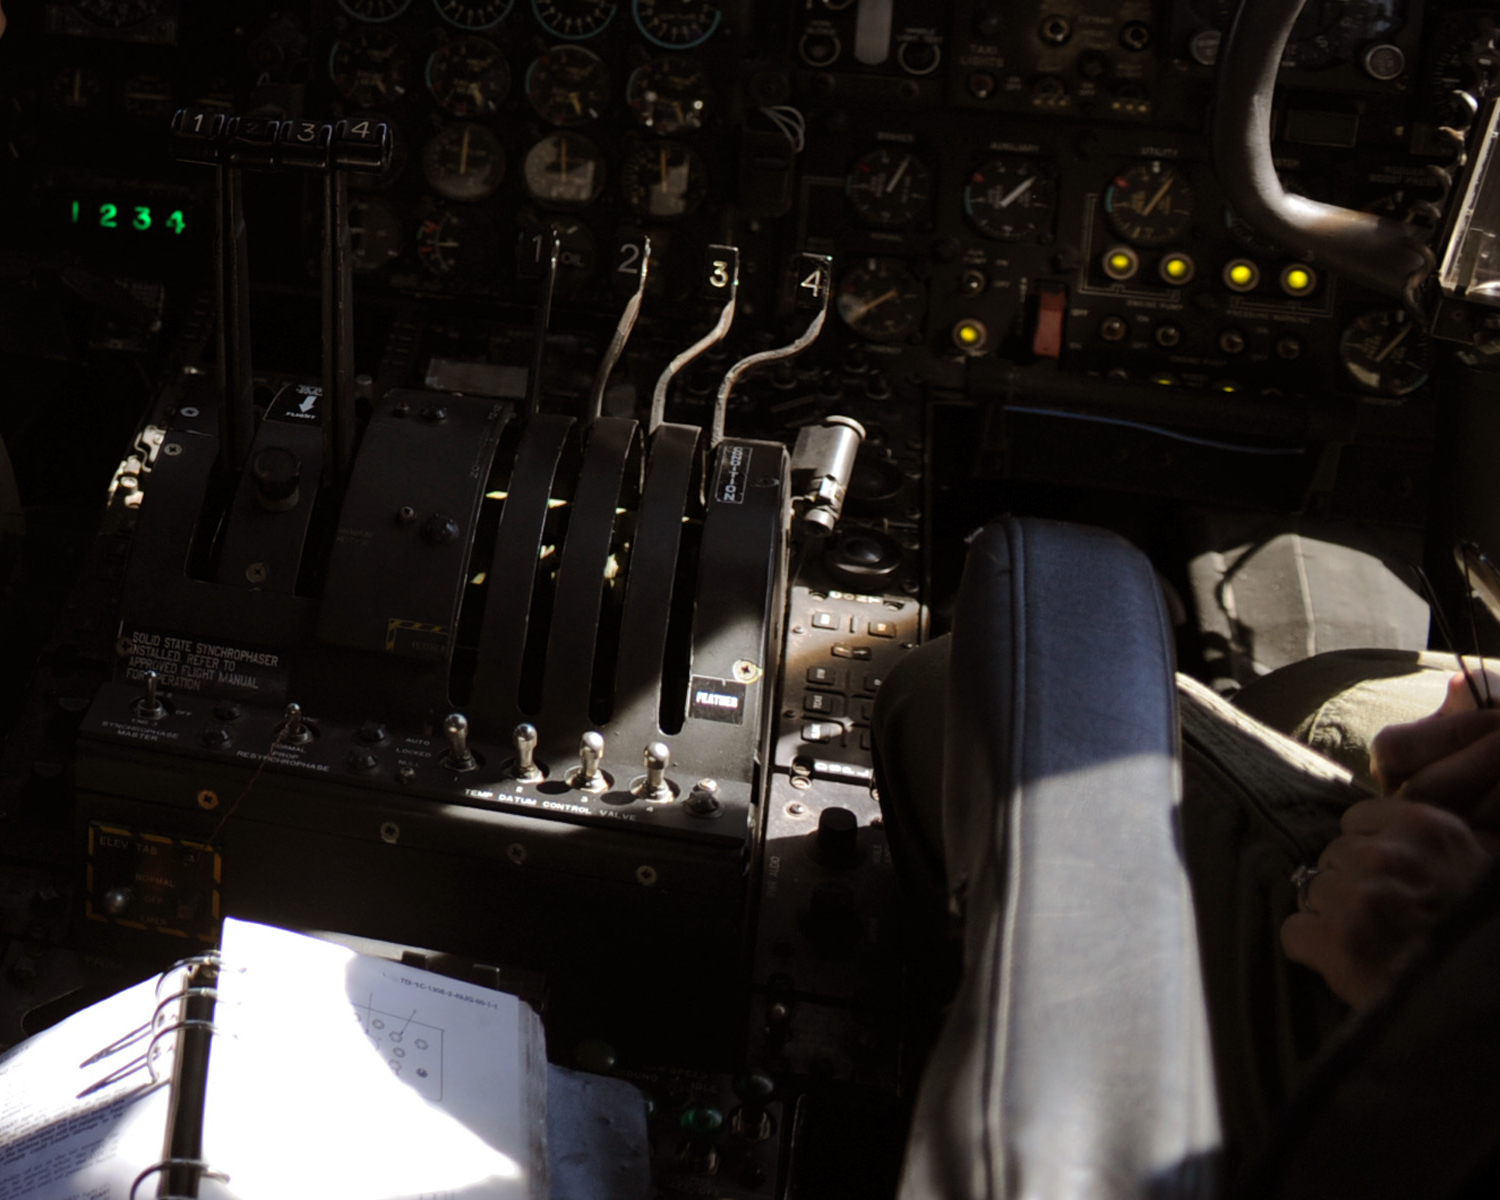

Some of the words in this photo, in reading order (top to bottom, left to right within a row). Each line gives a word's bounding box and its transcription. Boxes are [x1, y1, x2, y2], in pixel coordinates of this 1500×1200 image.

[193, 113, 204, 133] 1
[245, 121, 261, 135] 2
[296, 122, 316, 142] 3
[350, 120, 371, 139] 4
[70, 199, 80, 225] 1
[99, 202, 119, 229] 2
[131, 204, 152, 231] 3
[164, 208, 187, 236] 4
[531, 234, 543, 263] 1
[617, 243, 641, 275] 2
[708, 259, 729, 289] 3
[800, 268, 823, 298] 4
[132, 631, 161, 646] SOLID
[164, 636, 193, 653] STATE
[195, 642, 280, 668] SYNCHROPHASER
[129, 656, 179, 675] APPROVED
[180, 663, 217, 682] FLIGHT
[216, 670, 260, 690] MANUAL
[186, 652, 220, 671] REFER
[223, 659, 237, 672] TO
[125, 667, 146, 682] FOR
[148, 672, 201, 692] PERATION
[696, 690, 739, 709] FEATHER
[101, 720, 179, 740] SYNCHROPHASE
[116, 729, 159, 741] MASTER
[396, 747, 432, 758] LOCKED
[405, 737, 431, 746] AUTO
[464, 788, 494, 799] TEMP
[498, 793, 538, 807] DATUM
[542, 800, 593, 815] CONTROL
[599, 809, 638, 821] VALVE
[100, 834, 129, 849] ELEV
[135, 842, 159, 856] TAB
[135, 873, 176, 889] NORMAL
